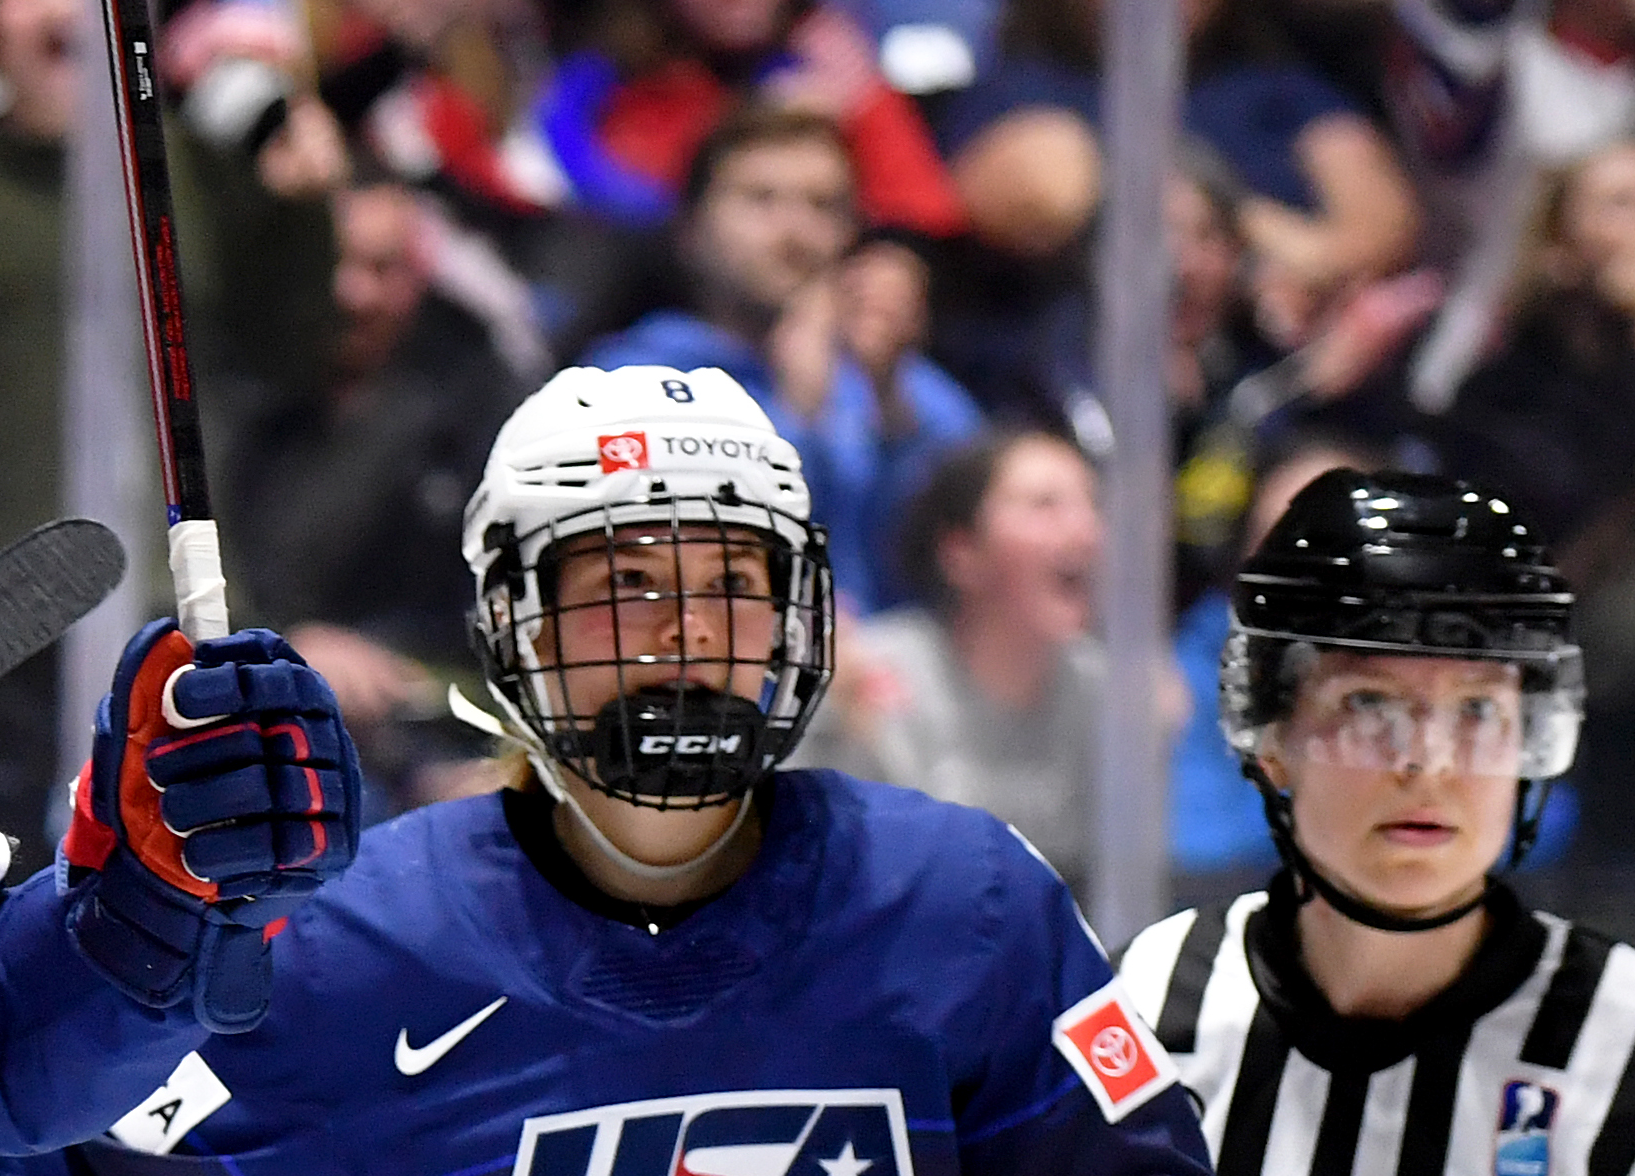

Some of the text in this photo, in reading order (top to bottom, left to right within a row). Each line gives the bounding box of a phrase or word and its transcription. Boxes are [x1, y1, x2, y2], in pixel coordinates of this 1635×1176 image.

[660, 379, 696, 403] 8
[661, 436, 770, 463] TOYOTA
[638, 734, 741, 755] CCM
